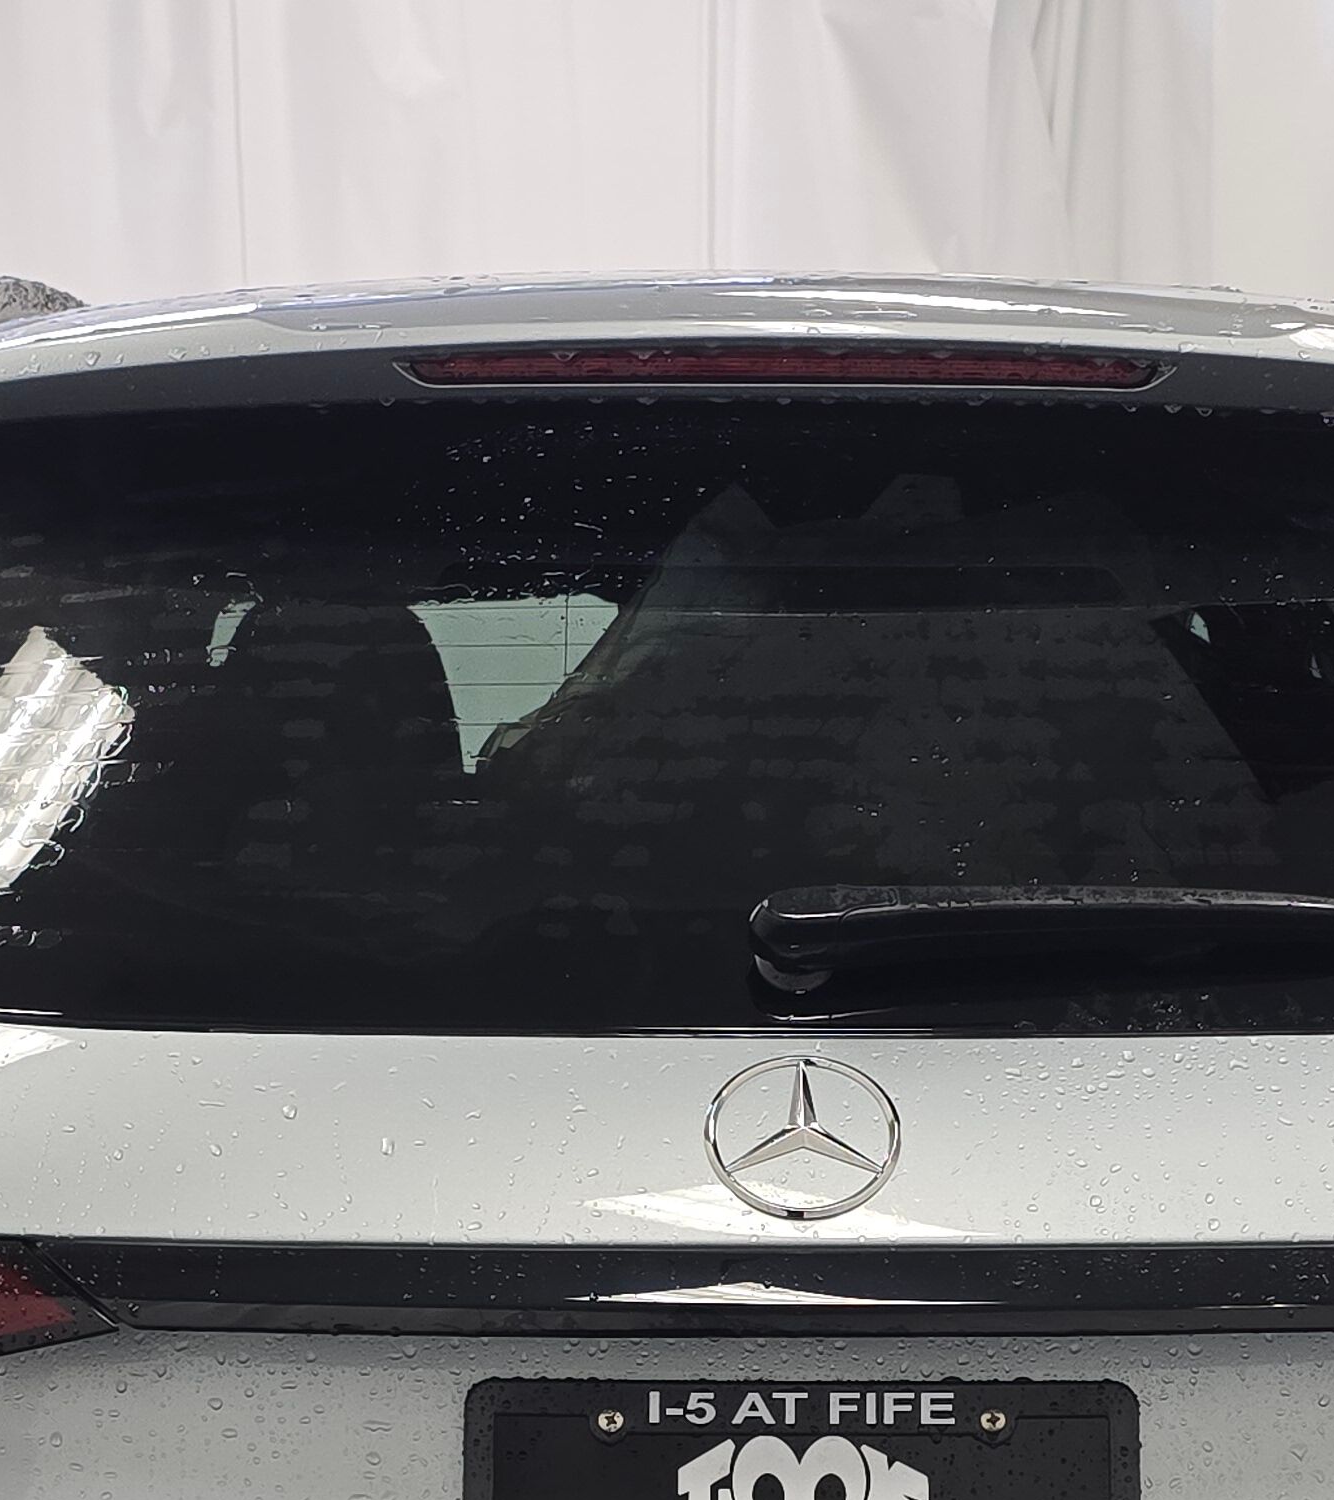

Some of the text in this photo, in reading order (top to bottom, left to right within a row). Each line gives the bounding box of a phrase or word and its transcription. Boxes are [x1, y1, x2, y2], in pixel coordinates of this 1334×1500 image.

[648, 1391, 956, 1425] I-5 AT FIFE
